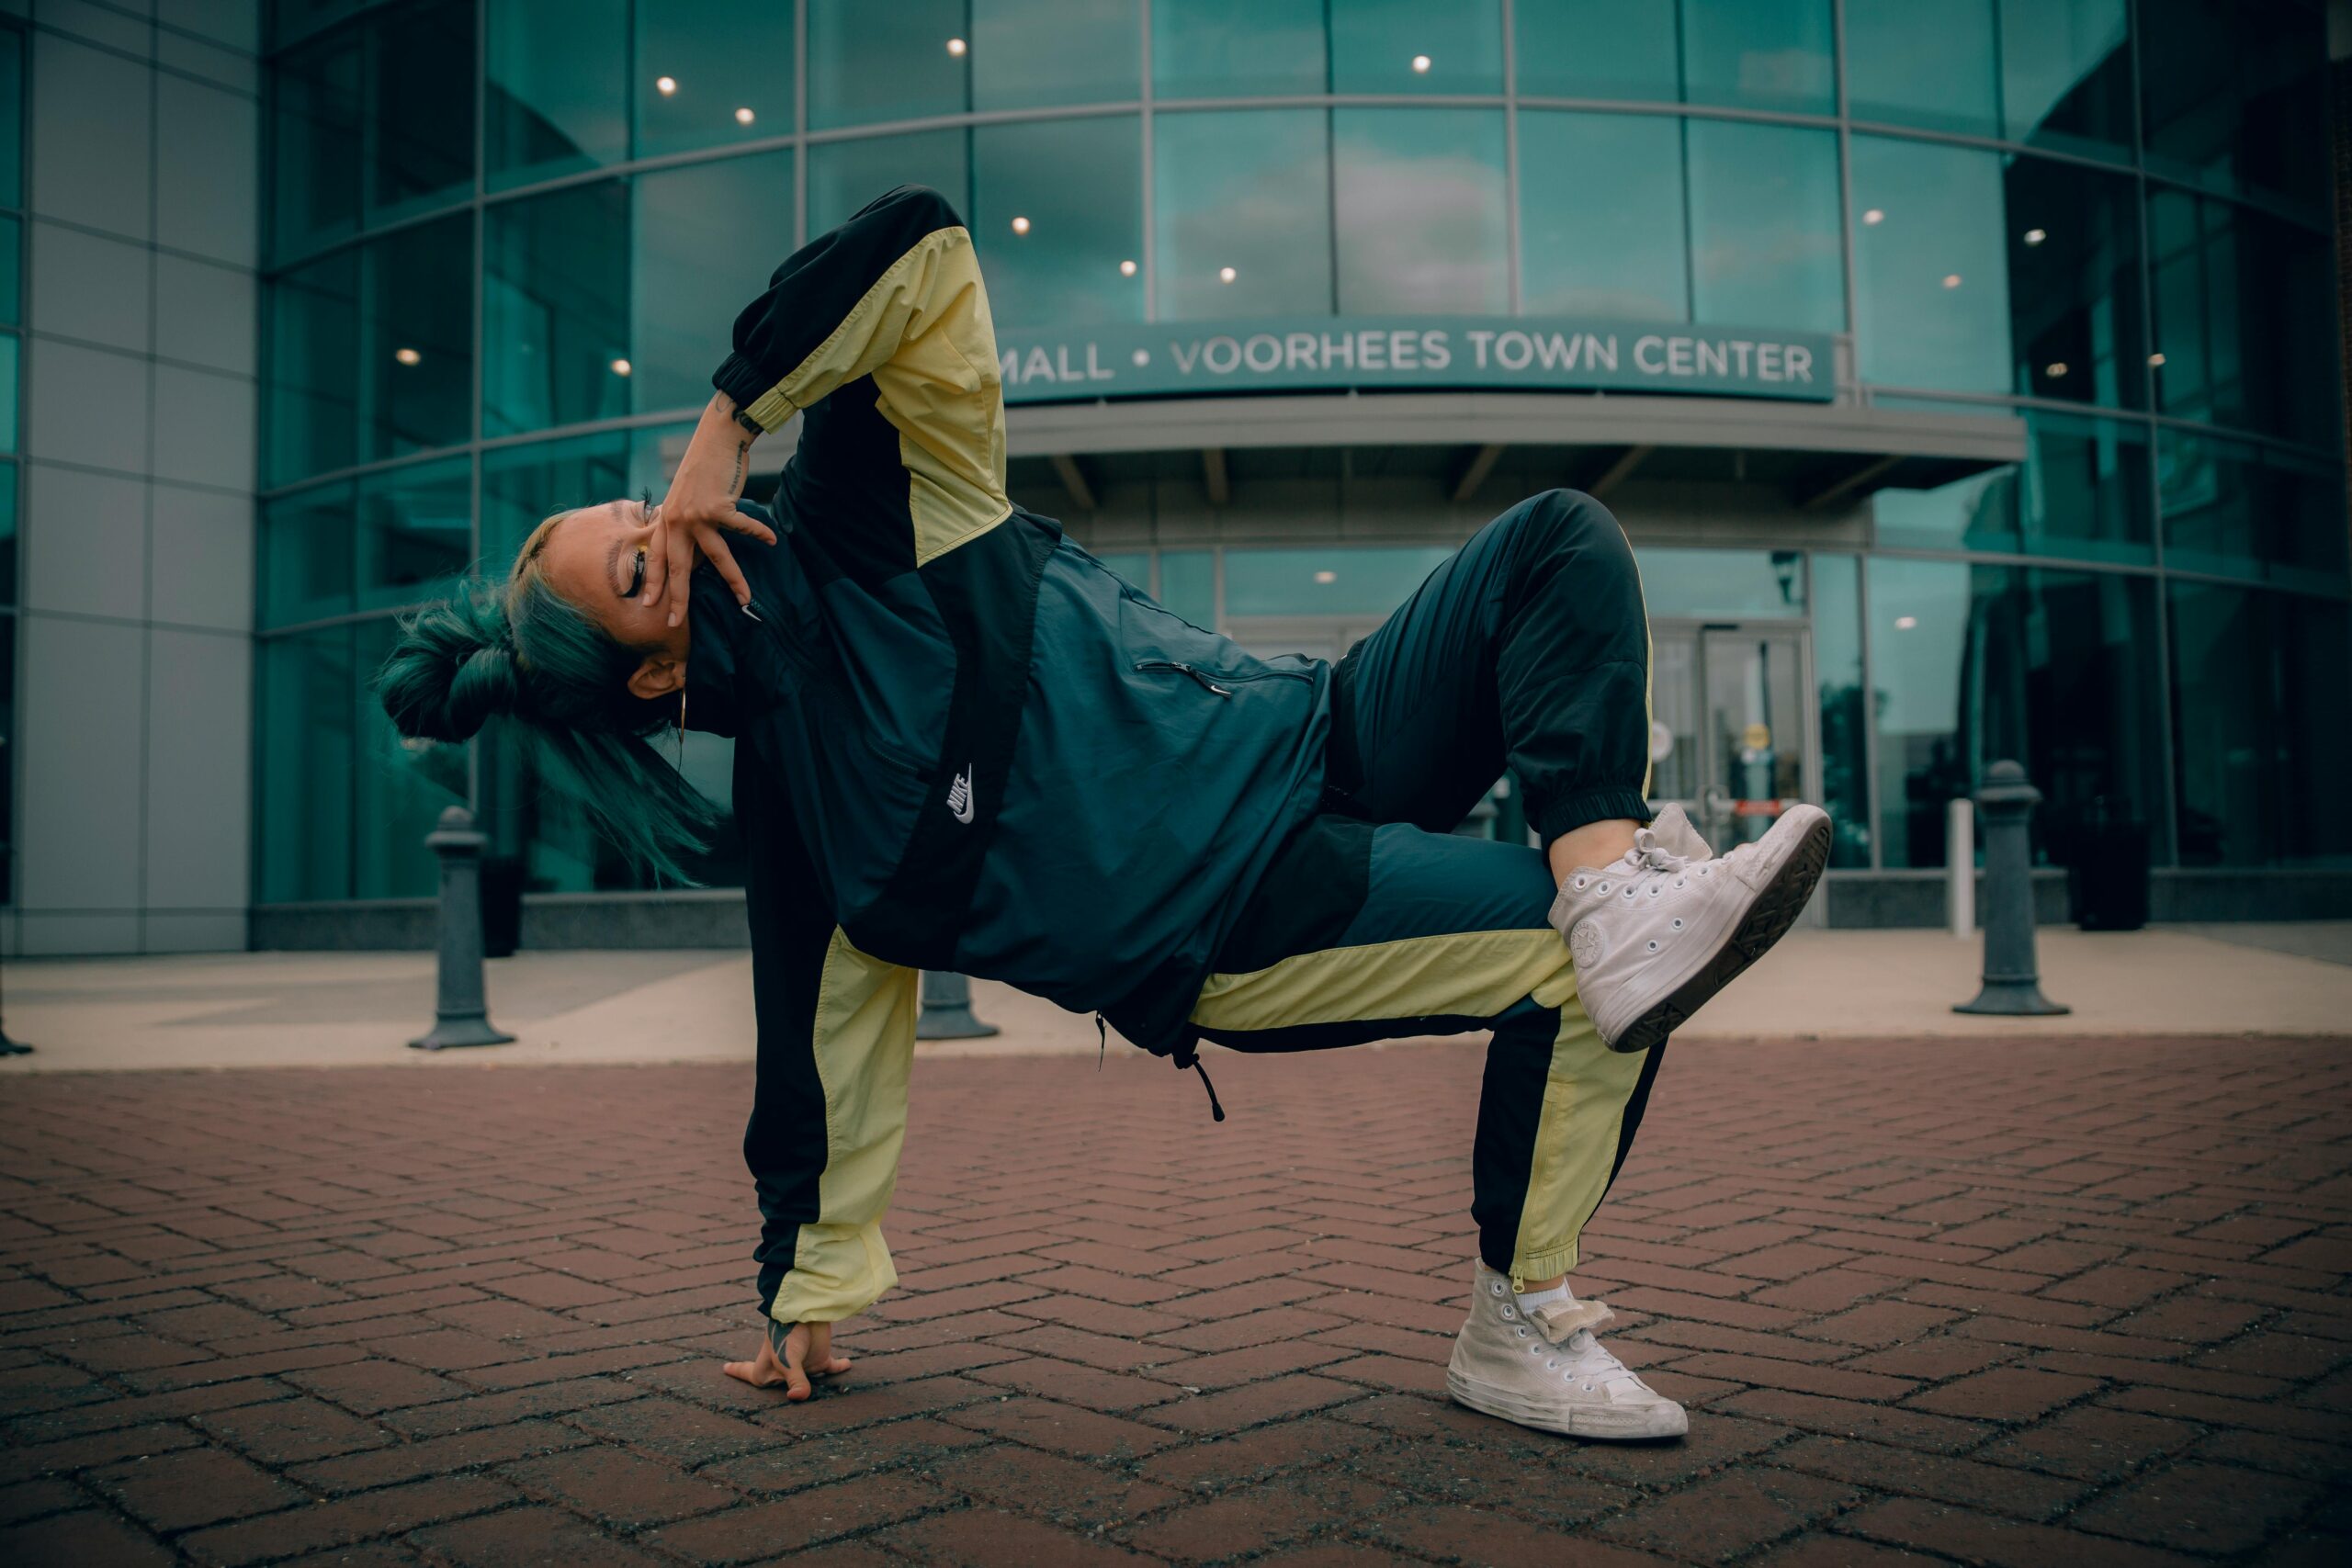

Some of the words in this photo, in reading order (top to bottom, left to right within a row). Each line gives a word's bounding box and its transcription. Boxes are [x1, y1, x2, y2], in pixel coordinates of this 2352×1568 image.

[1170, 330, 1451, 375] VOORHEES
[1466, 330, 1618, 370] TOWN
[1634, 334, 1814, 383] CENTER
[946, 773, 969, 814] NIKE
